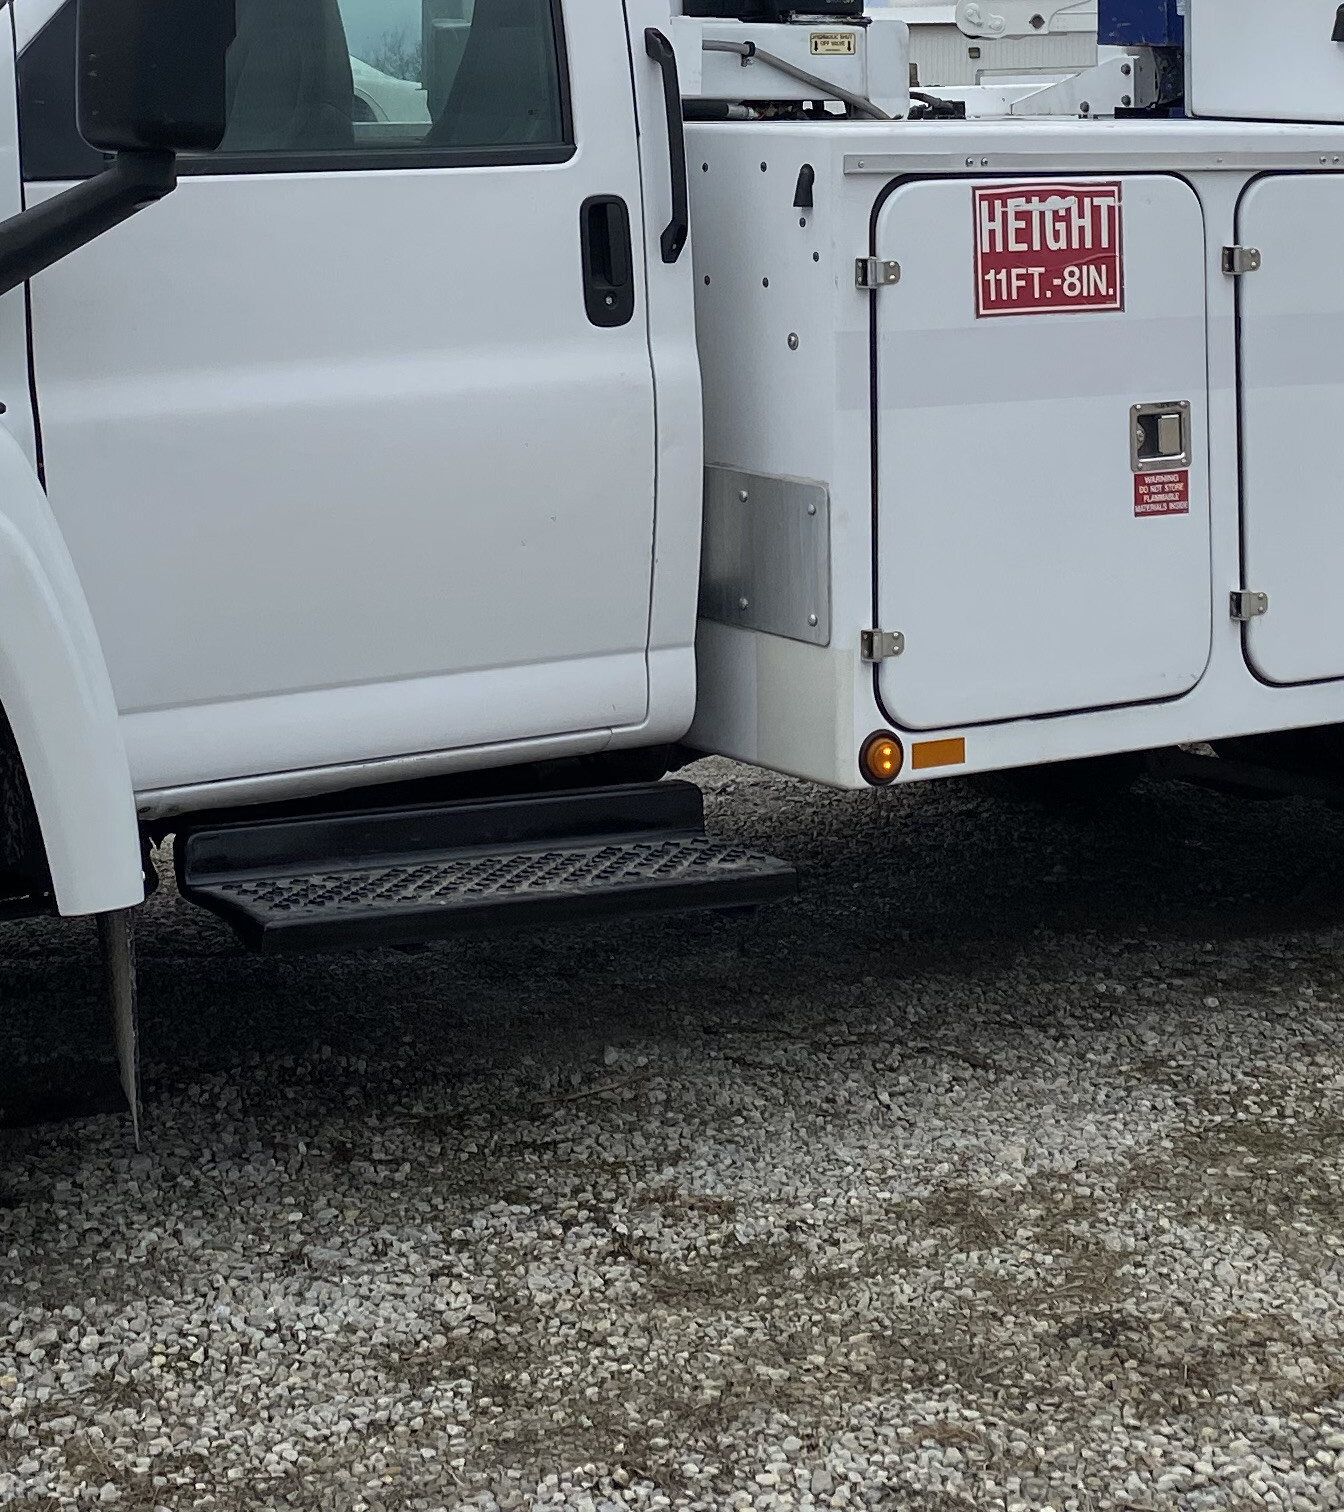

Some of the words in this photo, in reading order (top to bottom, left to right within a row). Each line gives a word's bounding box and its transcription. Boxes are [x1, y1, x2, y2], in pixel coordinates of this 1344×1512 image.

[980, 195, 1116, 253] HEIGHT
[1144, 474, 1179, 483] WARNING
[1138, 486, 1149, 494] DO
[1149, 484, 1163, 492] NOT
[1164, 482, 1184, 492] STORE
[1135, 502, 1167, 512] MATERIALS
